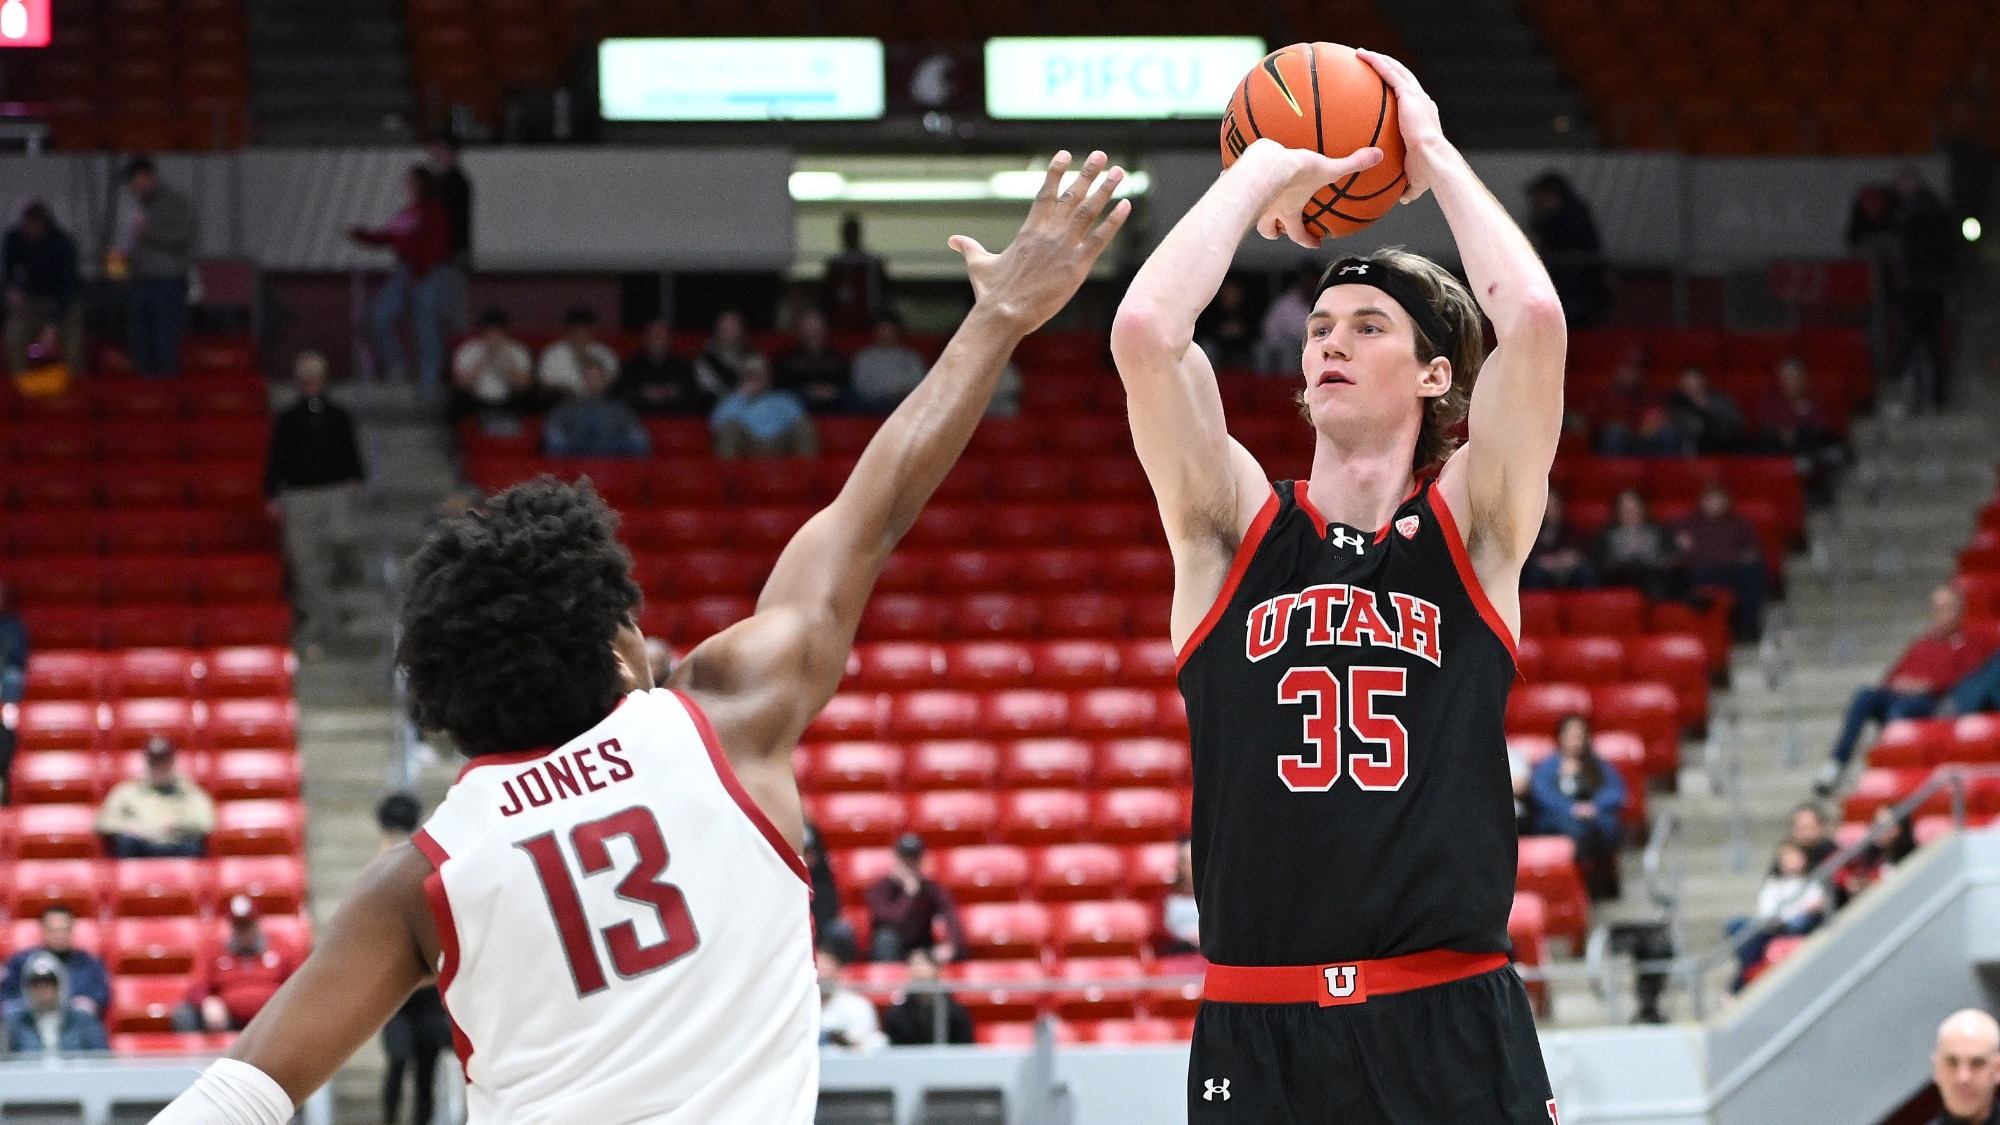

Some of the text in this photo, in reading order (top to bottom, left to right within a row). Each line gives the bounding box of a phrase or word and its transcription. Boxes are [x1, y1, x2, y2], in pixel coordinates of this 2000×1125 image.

[1045, 54, 1201, 100] PIFCU
[1246, 583, 1441, 668] UTAH
[1277, 665, 1408, 792] 35
[499, 737, 634, 817] JONES
[511, 804, 700, 1000] 13
[1323, 965, 1357, 998] U
